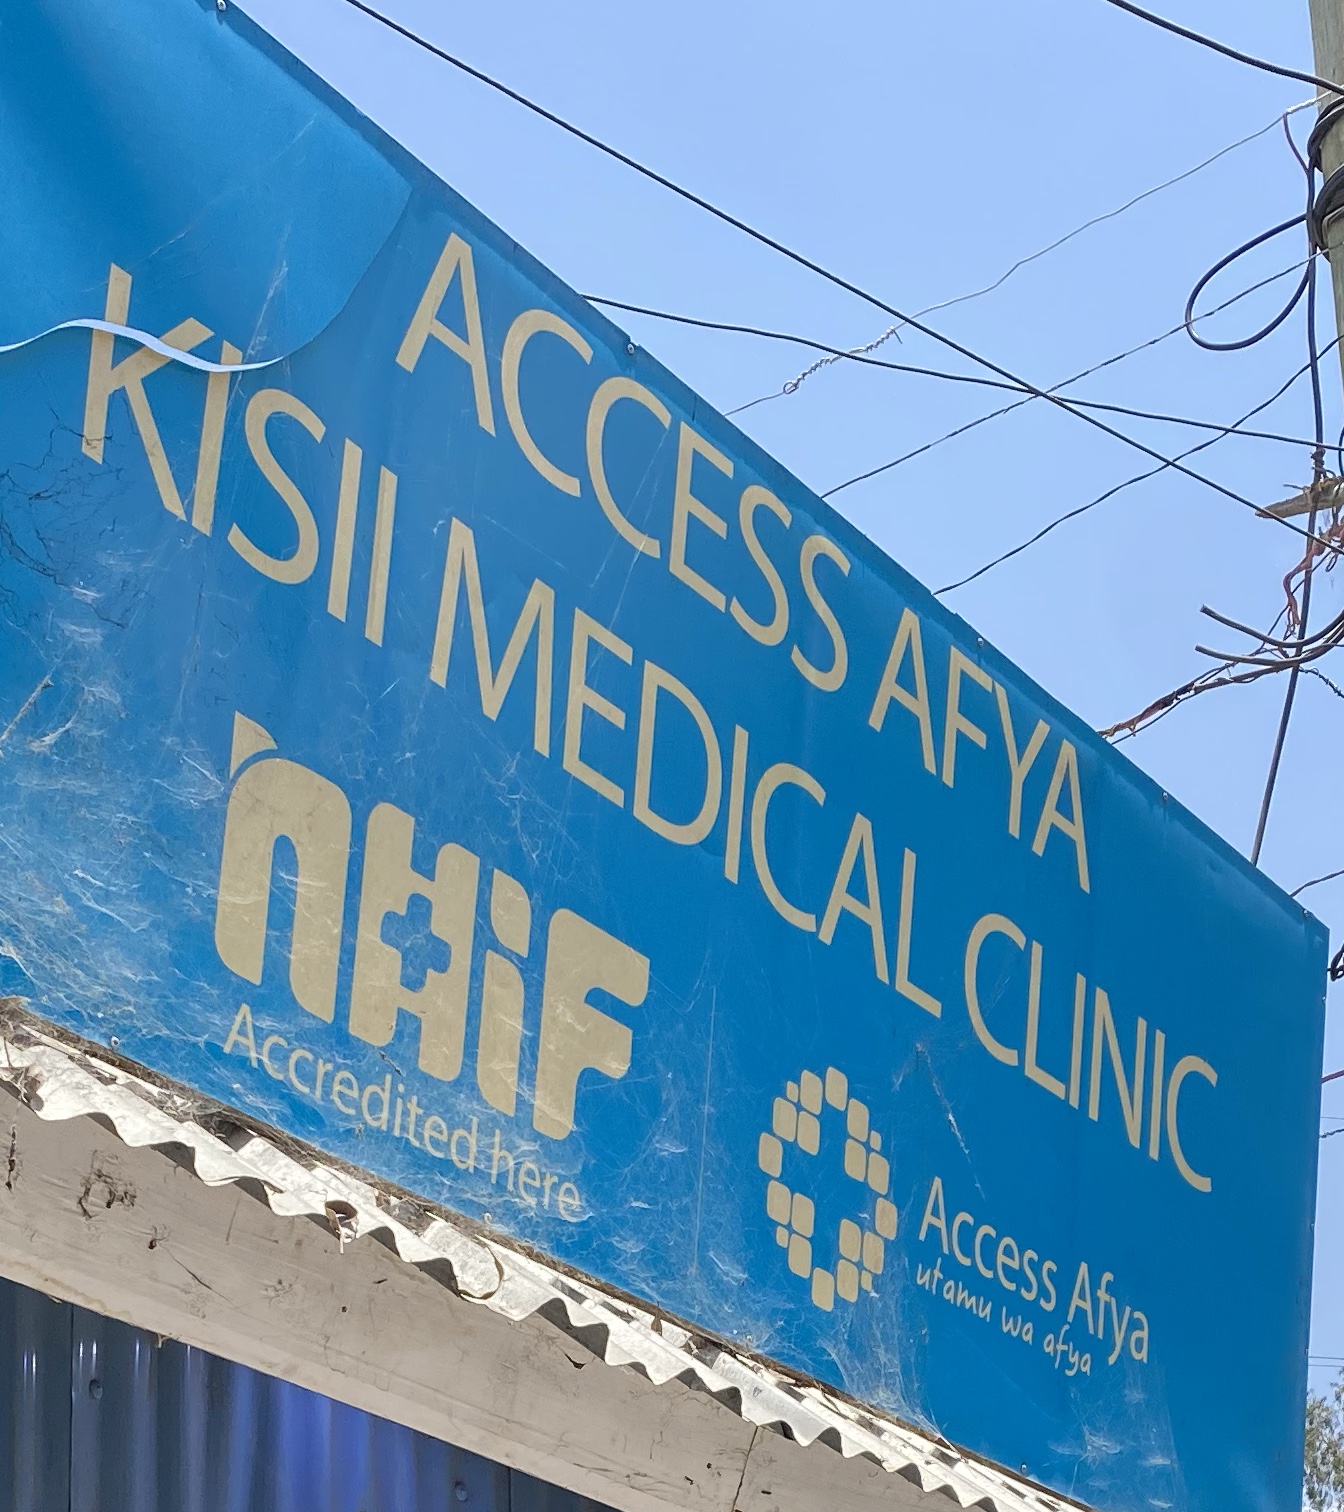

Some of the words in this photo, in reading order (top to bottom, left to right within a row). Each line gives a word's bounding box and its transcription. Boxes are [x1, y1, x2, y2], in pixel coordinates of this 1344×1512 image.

[396, 232, 851, 692] ACCESS
[868, 609, 1090, 893] AFYA
[81, 263, 398, 648] KISII
[429, 517, 942, 1018] MEDICAL
[965, 913, 1218, 1193] CLINIC
[223, 1004, 478, 1173] Accredited
[491, 1130, 581, 1219] here
[916, 1257, 992, 1320] utamu
[1002, 1306, 1033, 1344] wa
[1043, 1323, 1092, 1377] afya
[918, 1176, 1058, 1312] Access
[1067, 1262, 1150, 1366] Afya
